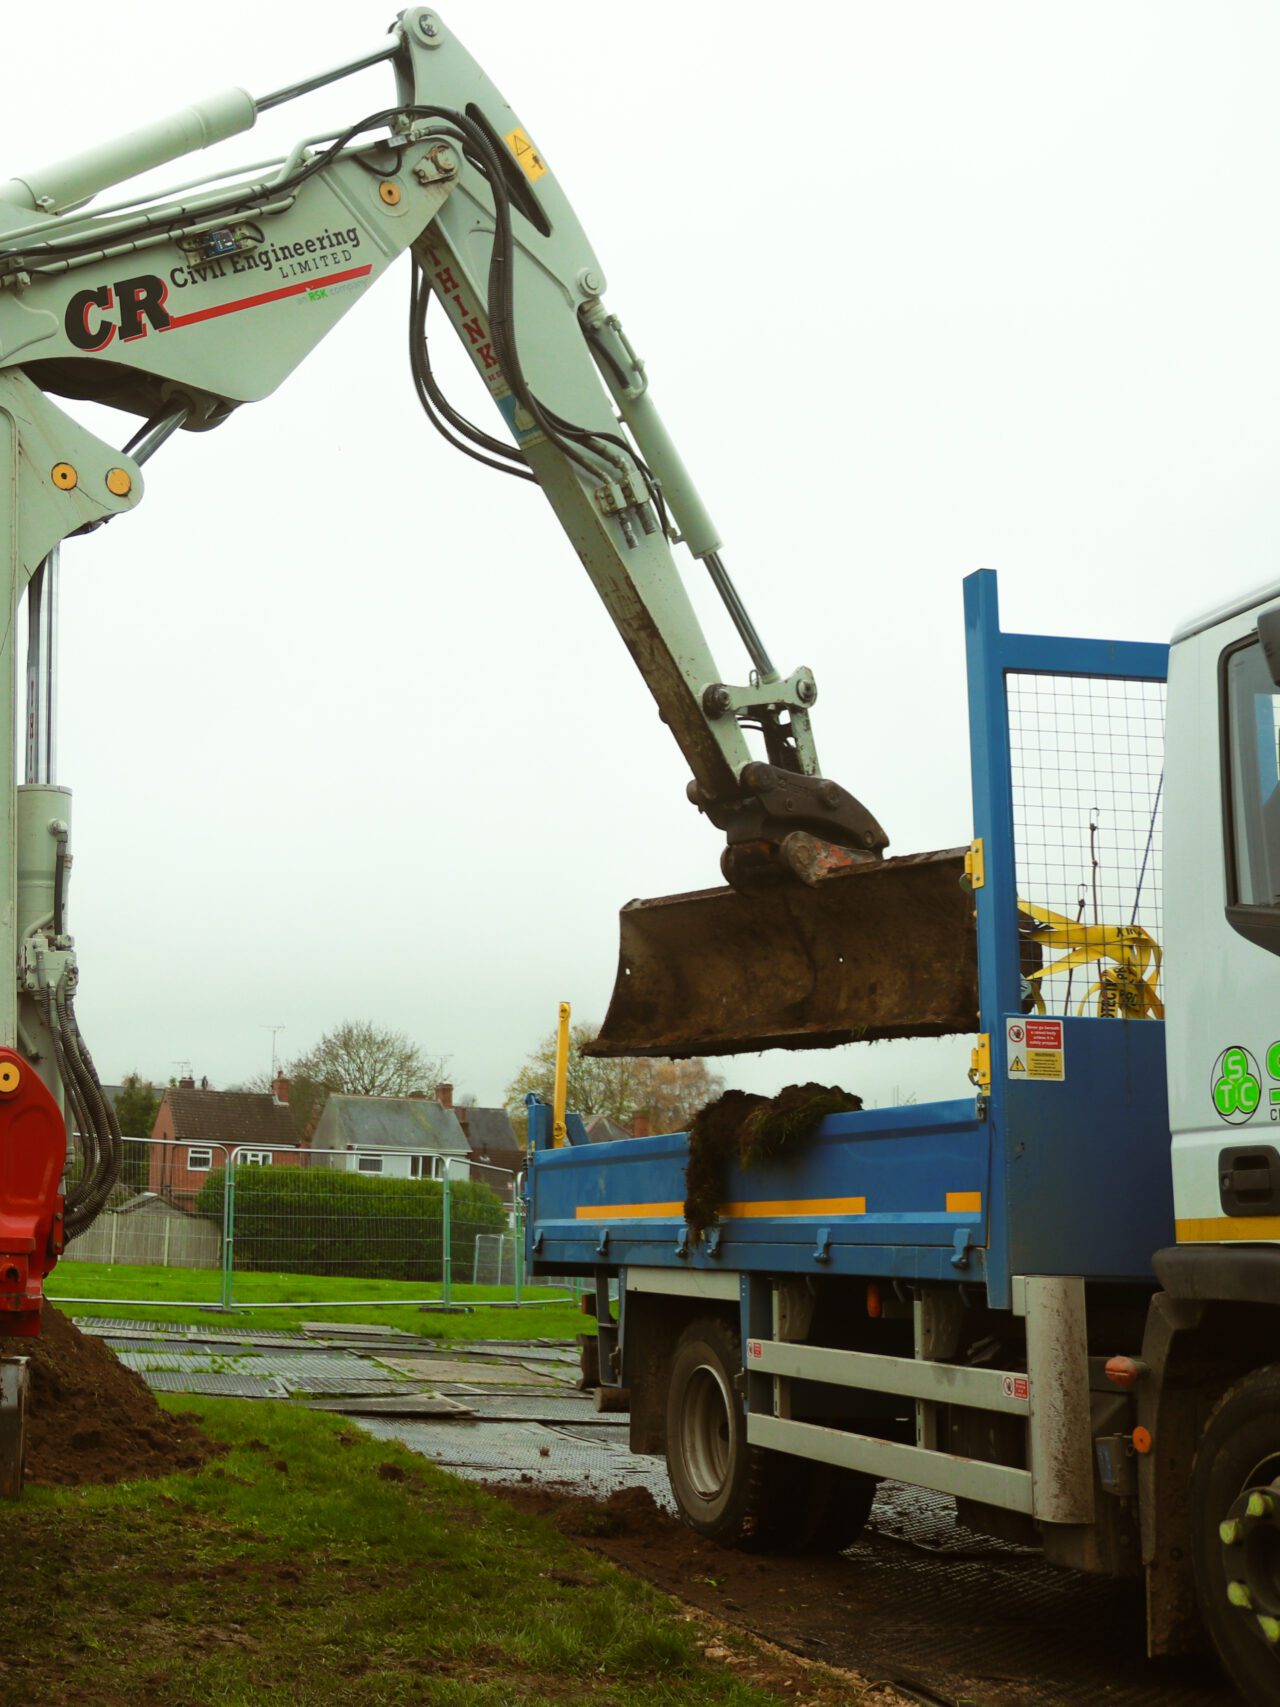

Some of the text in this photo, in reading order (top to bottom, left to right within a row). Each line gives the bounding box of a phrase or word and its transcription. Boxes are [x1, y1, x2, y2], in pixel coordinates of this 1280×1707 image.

[64, 226, 361, 352] CR Civil Engineering
[278, 249, 352, 279] LIMITED
[308, 289, 328, 302] RSK
[423, 241, 499, 370] THINK
